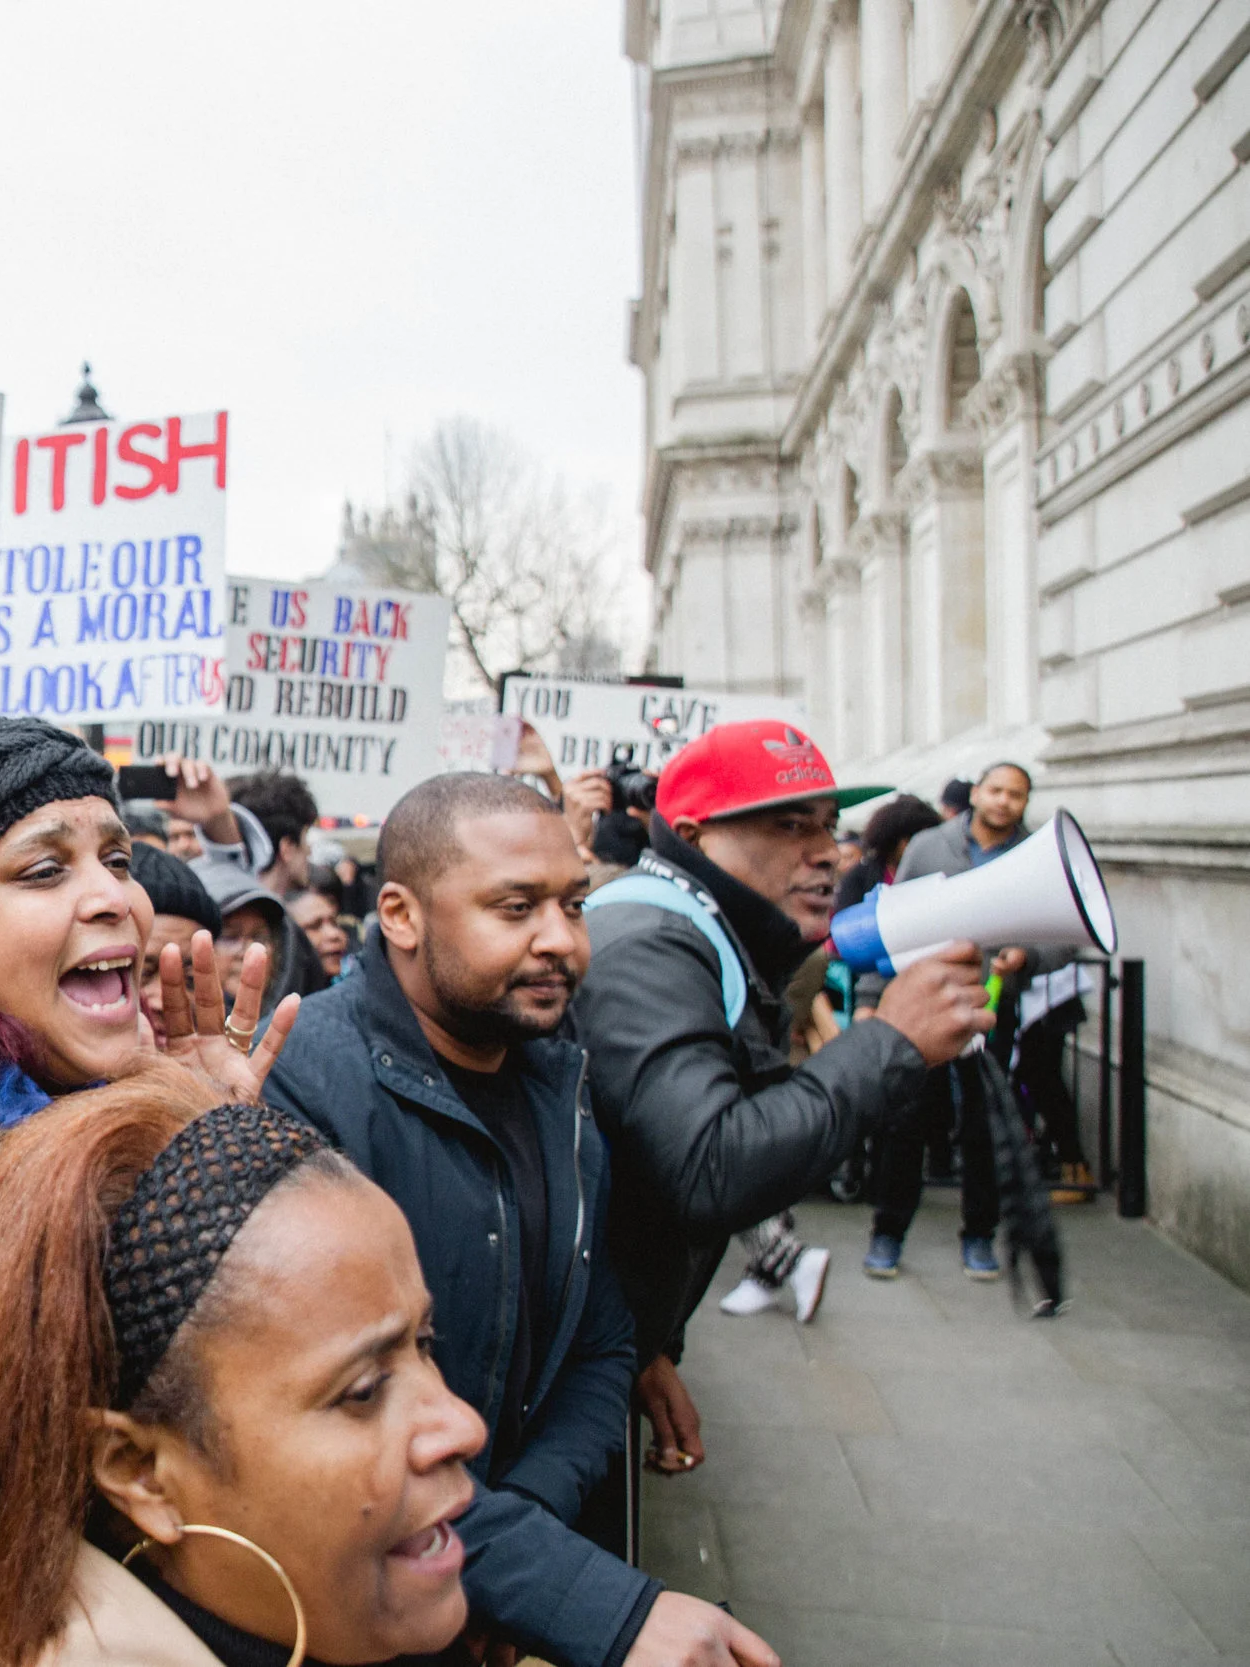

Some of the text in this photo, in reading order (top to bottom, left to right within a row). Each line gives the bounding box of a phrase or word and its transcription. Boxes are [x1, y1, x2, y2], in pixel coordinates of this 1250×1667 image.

[13, 411, 228, 516] ITISH
[110, 533, 203, 591] OUR
[31, 599, 58, 649] A
[76, 588, 224, 645] MORAL
[270, 589, 310, 631] US
[333, 593, 414, 642] BACK
[0, 659, 108, 716] LOOK
[111, 653, 203, 711] AFTER
[246, 631, 393, 683] SECURITY
[274, 677, 410, 724] REBUILD
[514, 684, 574, 720] YOU
[138, 719, 200, 761] OUR
[211, 723, 398, 777] COMMUNITY
